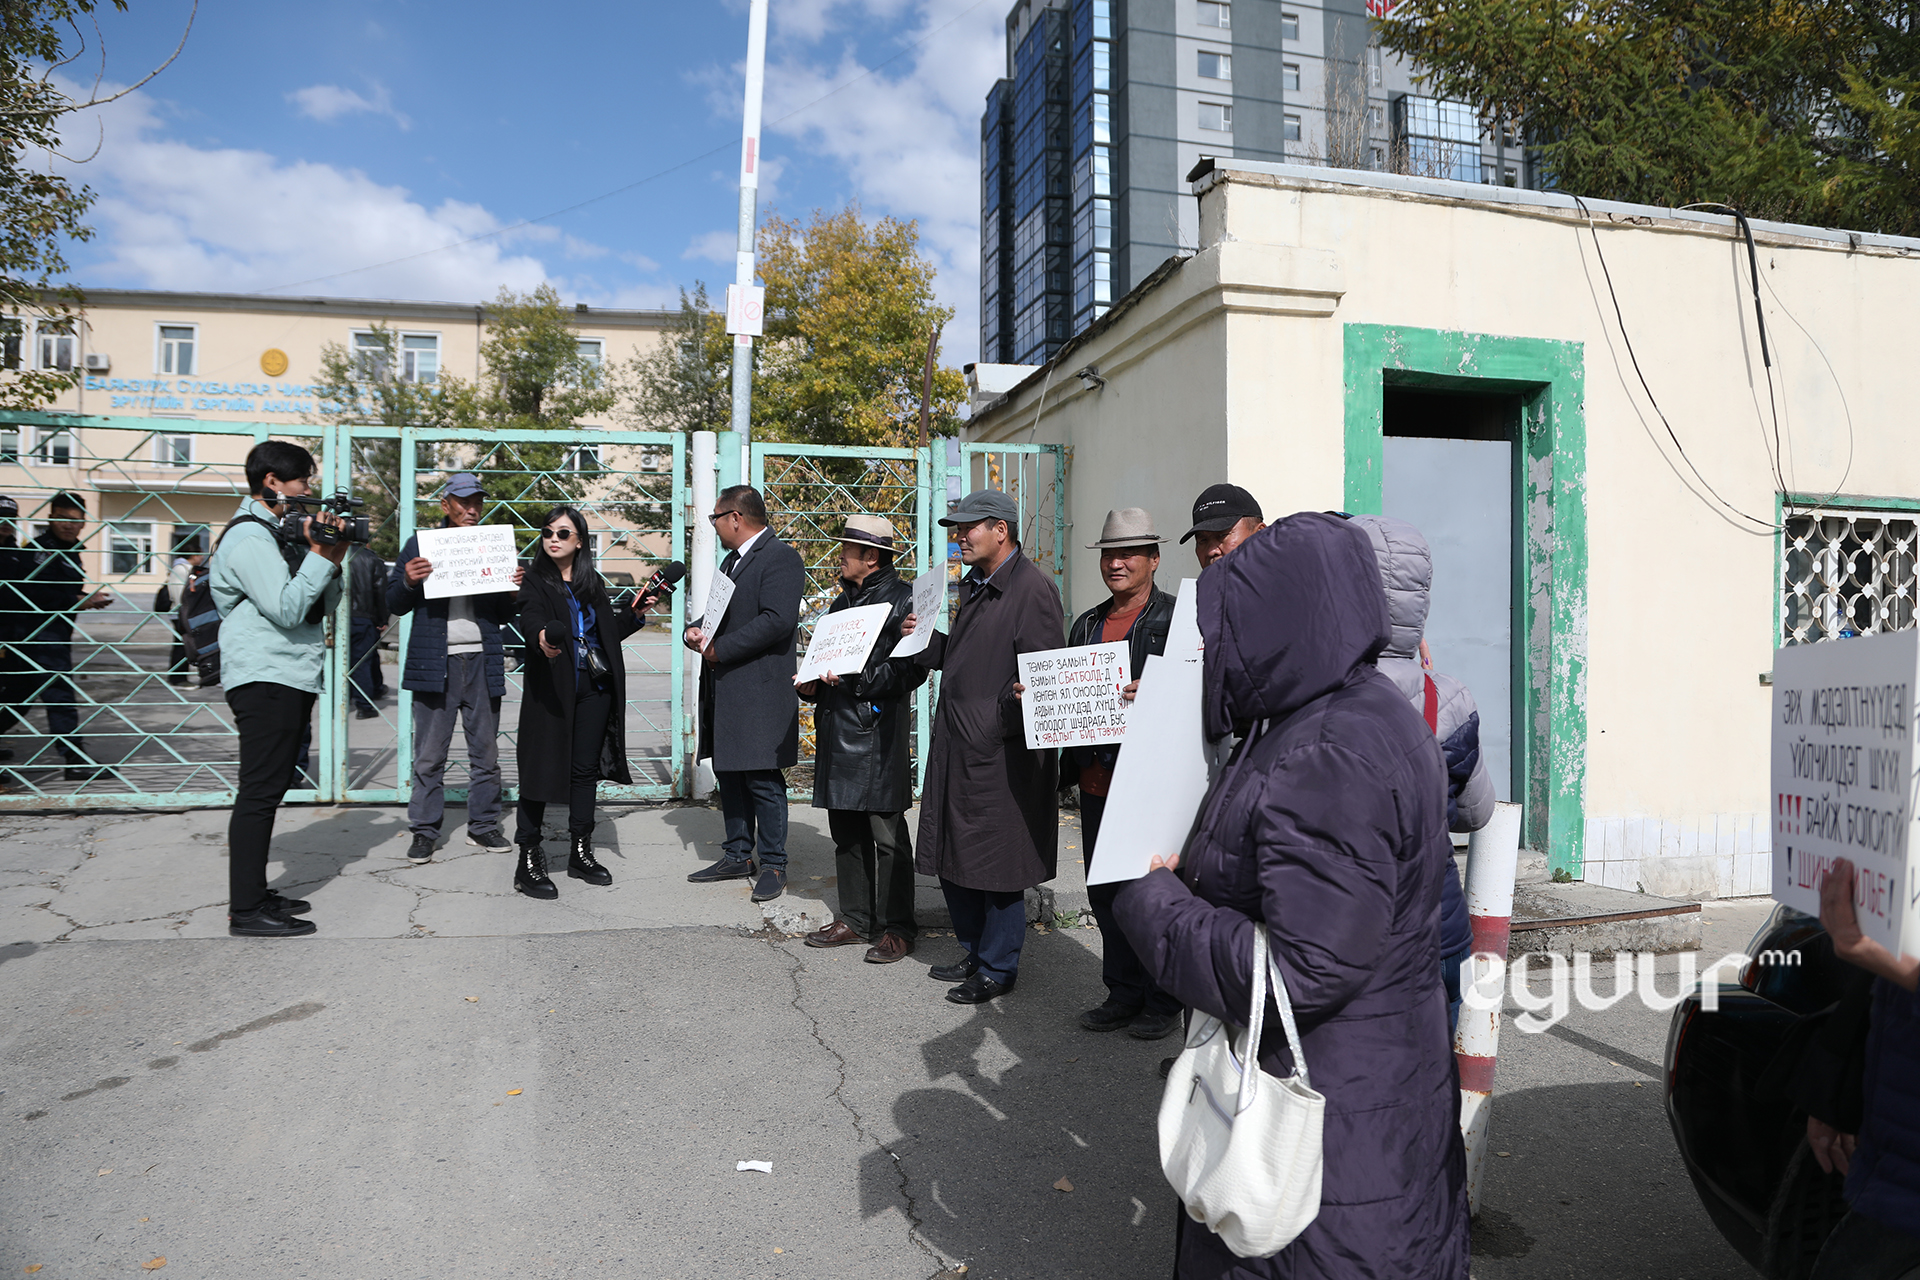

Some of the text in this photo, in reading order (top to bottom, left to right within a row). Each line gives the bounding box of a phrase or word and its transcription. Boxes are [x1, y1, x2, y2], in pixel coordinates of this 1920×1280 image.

[261, 400, 312, 413] АНХАН
[1026, 659, 1054, 673] ТӨМӨР
[1056, 655, 1088, 670] ЗАМЫН
[1030, 675, 1057, 687] БУМЫН
[1032, 689, 1058, 702] ХӨНГӨН
[1060, 688, 1071, 700] ЯЛ
[1033, 704, 1055, 719] АРДЫН
[1057, 701, 1092, 716] ХҮҮХДЭД
[1094, 698, 1116, 713] ХҮНД
[1783, 689, 1803, 725] ЭРХ
[1034, 713, 1127, 732] ОНООДОГ ШУДРАГА БУС
[1042, 730, 1075, 746] ЯВДЛЫГ
[1079, 728, 1096, 743] БИД
[1790, 734, 1901, 797] ҮЙЛЧИЛДЭГ ШҮҮХ
[1806, 791, 1842, 843] БАЙЖ
